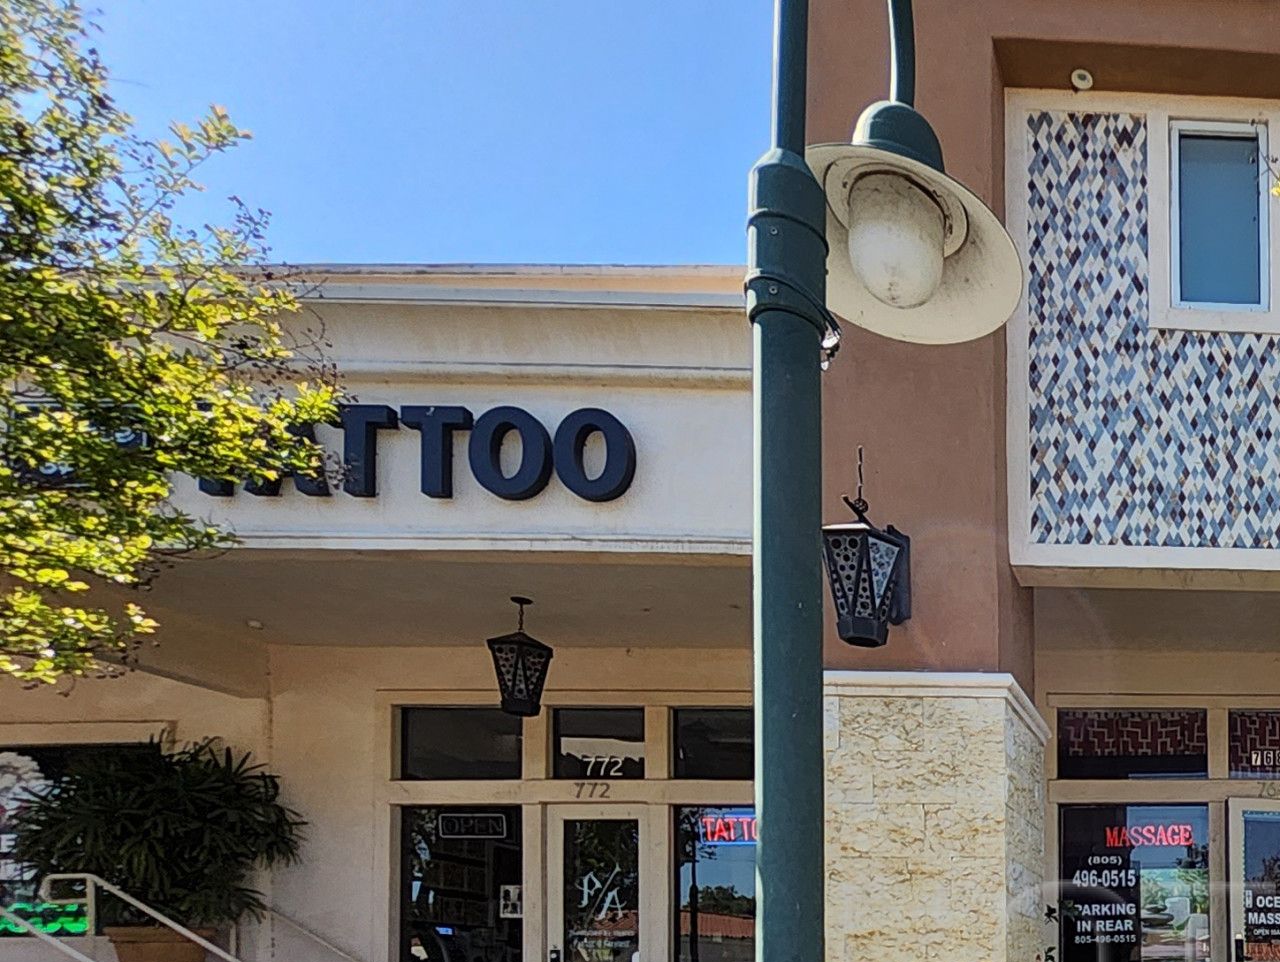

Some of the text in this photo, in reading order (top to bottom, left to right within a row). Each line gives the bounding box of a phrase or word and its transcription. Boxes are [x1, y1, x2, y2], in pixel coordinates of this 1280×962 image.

[190, 404, 637, 502] TTOO
[583, 757, 624, 776] 772
[574, 782, 612, 799] 772
[442, 817, 502, 834] OPEN
[1105, 824, 1193, 848] MASSAGE
[1087, 855, 1123, 866] (805)
[1072, 869, 1137, 888] 496-0515
[1076, 919, 1134, 933] IN REAR
[1074, 934, 1137, 945] 805-496-0515
